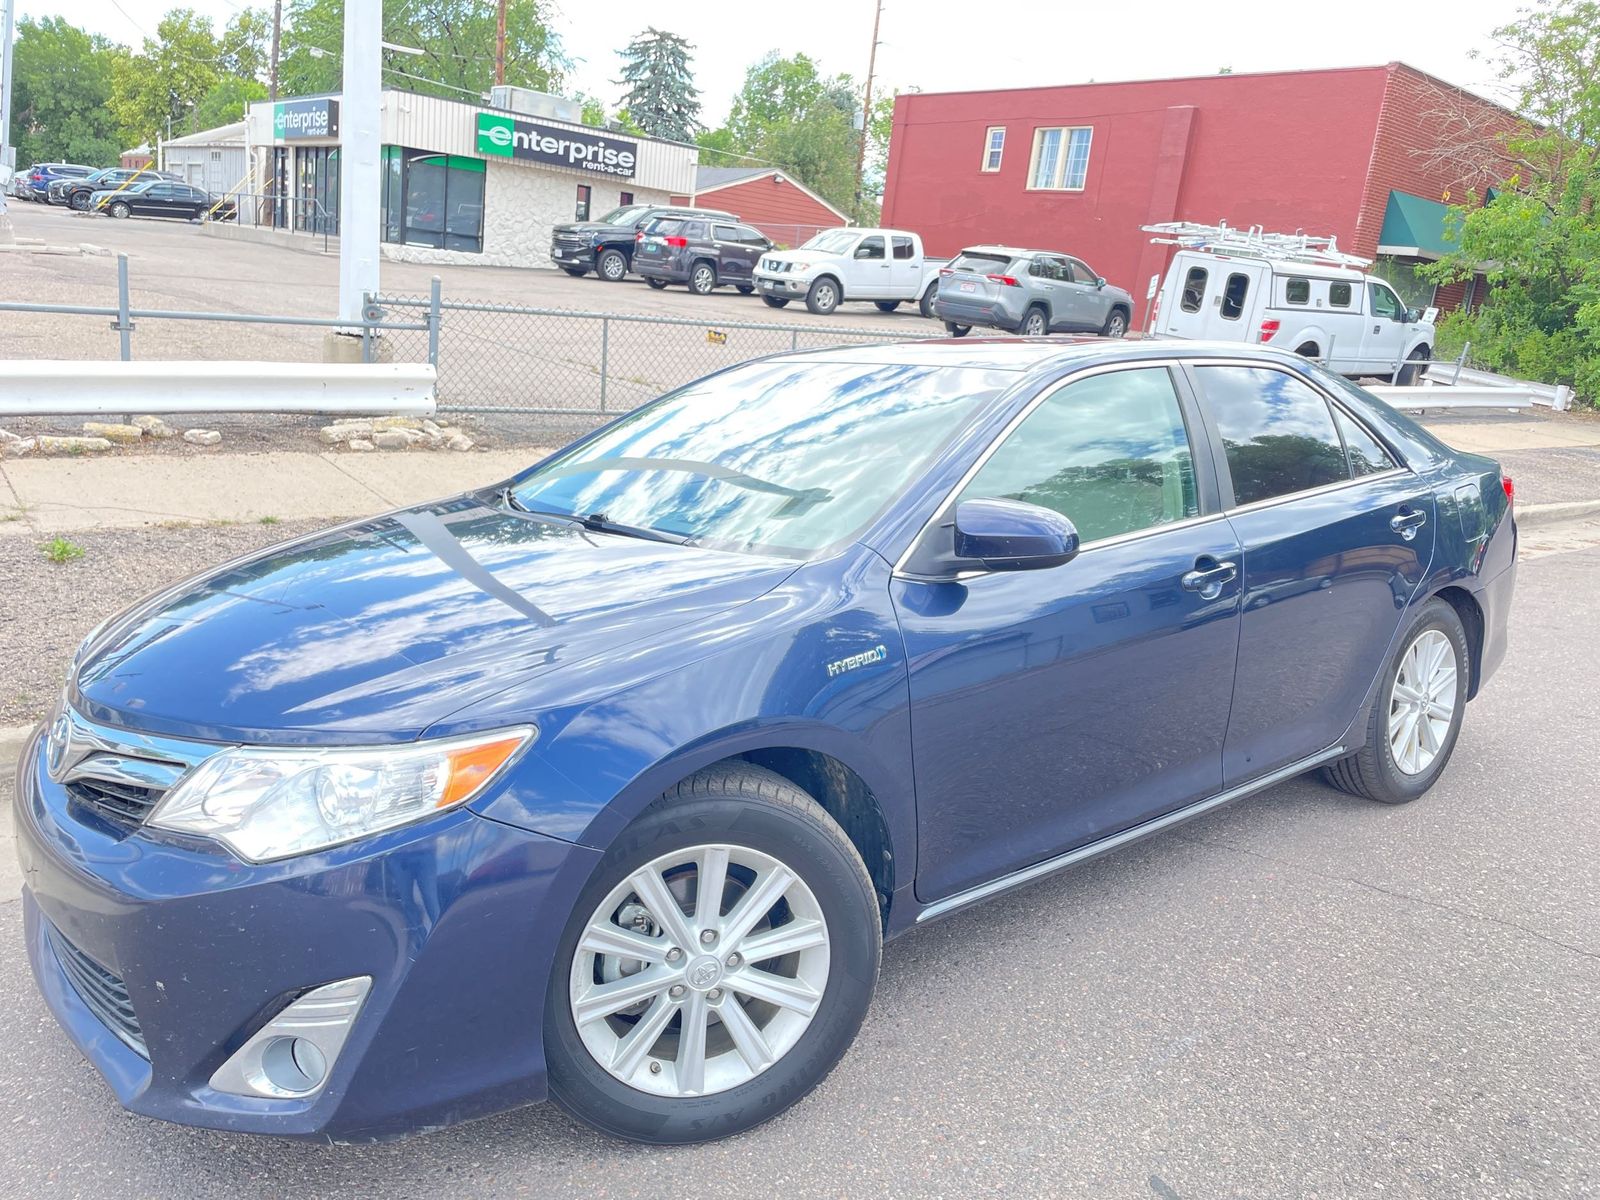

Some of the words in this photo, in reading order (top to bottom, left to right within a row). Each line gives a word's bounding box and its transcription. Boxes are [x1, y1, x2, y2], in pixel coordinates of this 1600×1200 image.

[275, 106, 328, 133] enterprise
[479, 126, 635, 167] enterprise
[583, 161, 633, 176] rent-a-car
[827, 649, 881, 677] HYBRID
